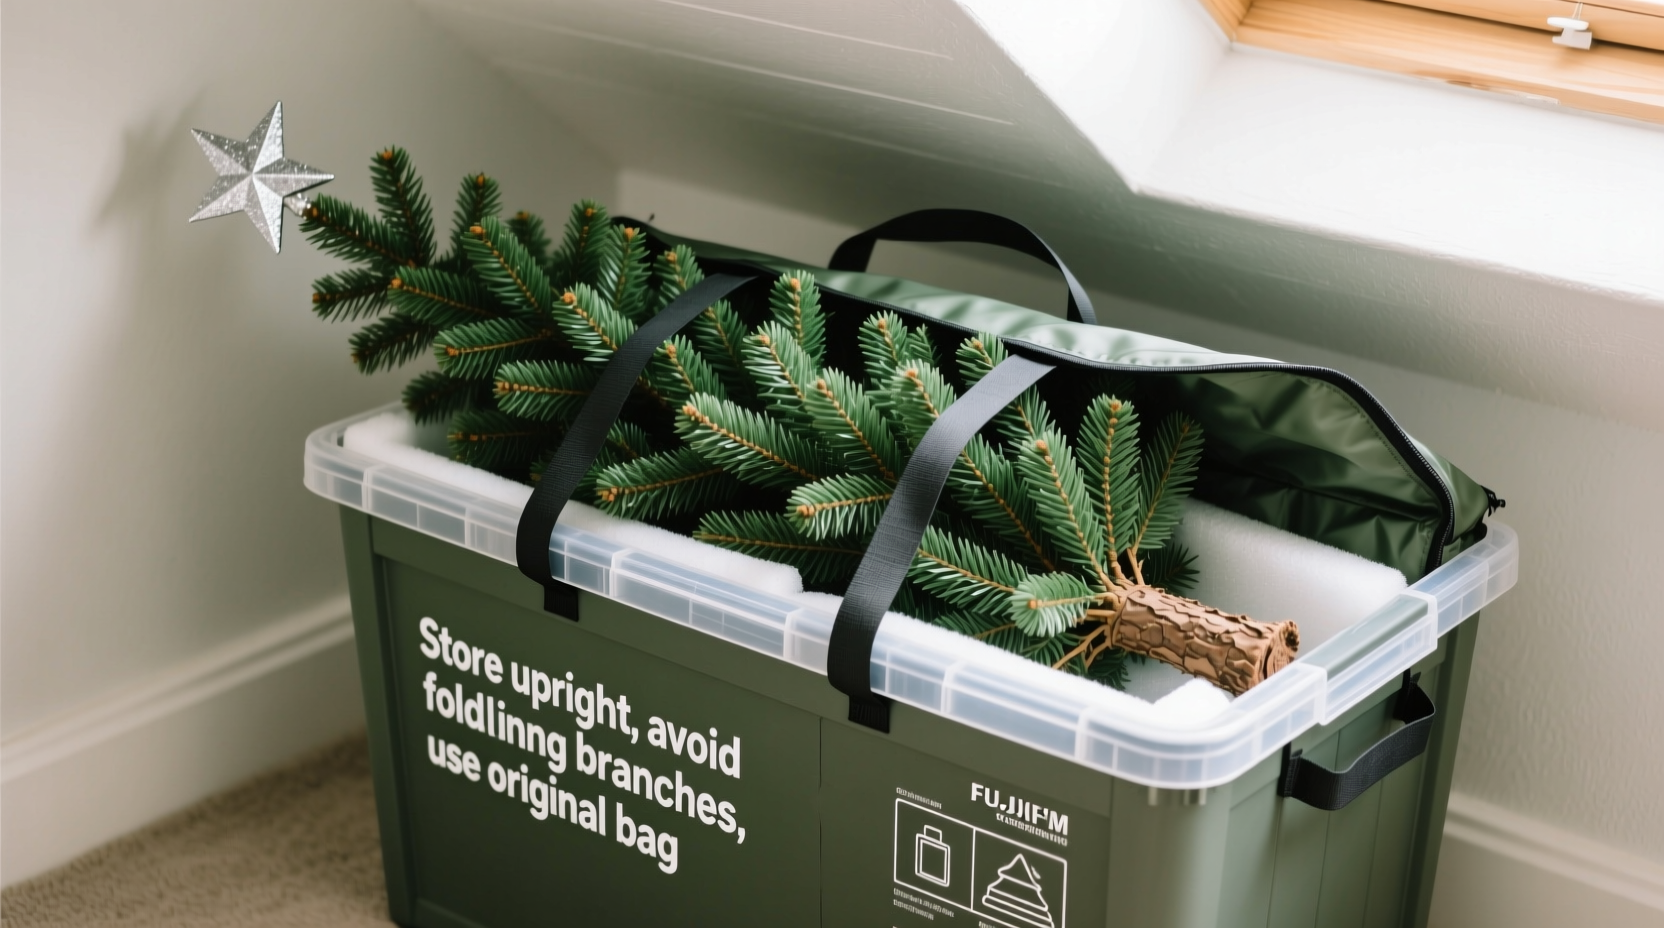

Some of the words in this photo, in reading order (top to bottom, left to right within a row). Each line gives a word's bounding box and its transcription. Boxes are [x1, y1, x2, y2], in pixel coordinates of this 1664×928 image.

[419, 616, 504, 684] Store
[510, 661, 639, 745] upright,
[647, 715, 741, 779] avoid
[427, 735, 481, 782] use
[487, 761, 606, 837] original
[616, 801, 679, 875] bag
[576, 731, 746, 845] branches,
